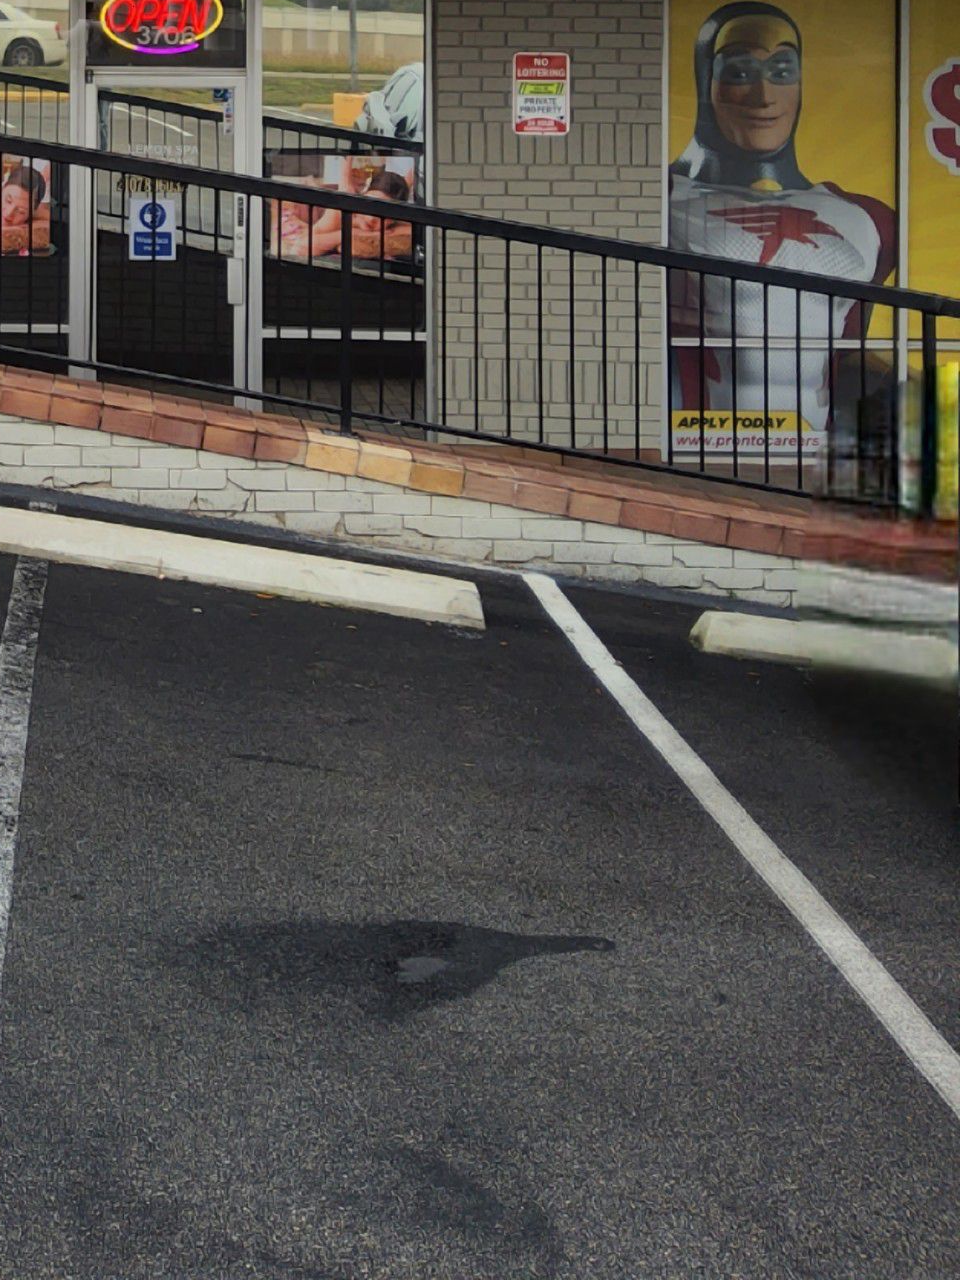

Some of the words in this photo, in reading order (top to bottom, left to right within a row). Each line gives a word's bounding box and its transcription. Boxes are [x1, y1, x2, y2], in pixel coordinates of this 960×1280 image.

[136, 25, 198, 45] 3706
[533, 57, 549, 66] NO
[516, 68, 566, 78] LOITERING
[128, 143, 171, 156] LEMON
[678, 416, 729, 428] APPLY
[734, 417, 786, 428] TODAY
[676, 435, 820, 448] www.prontocareers
